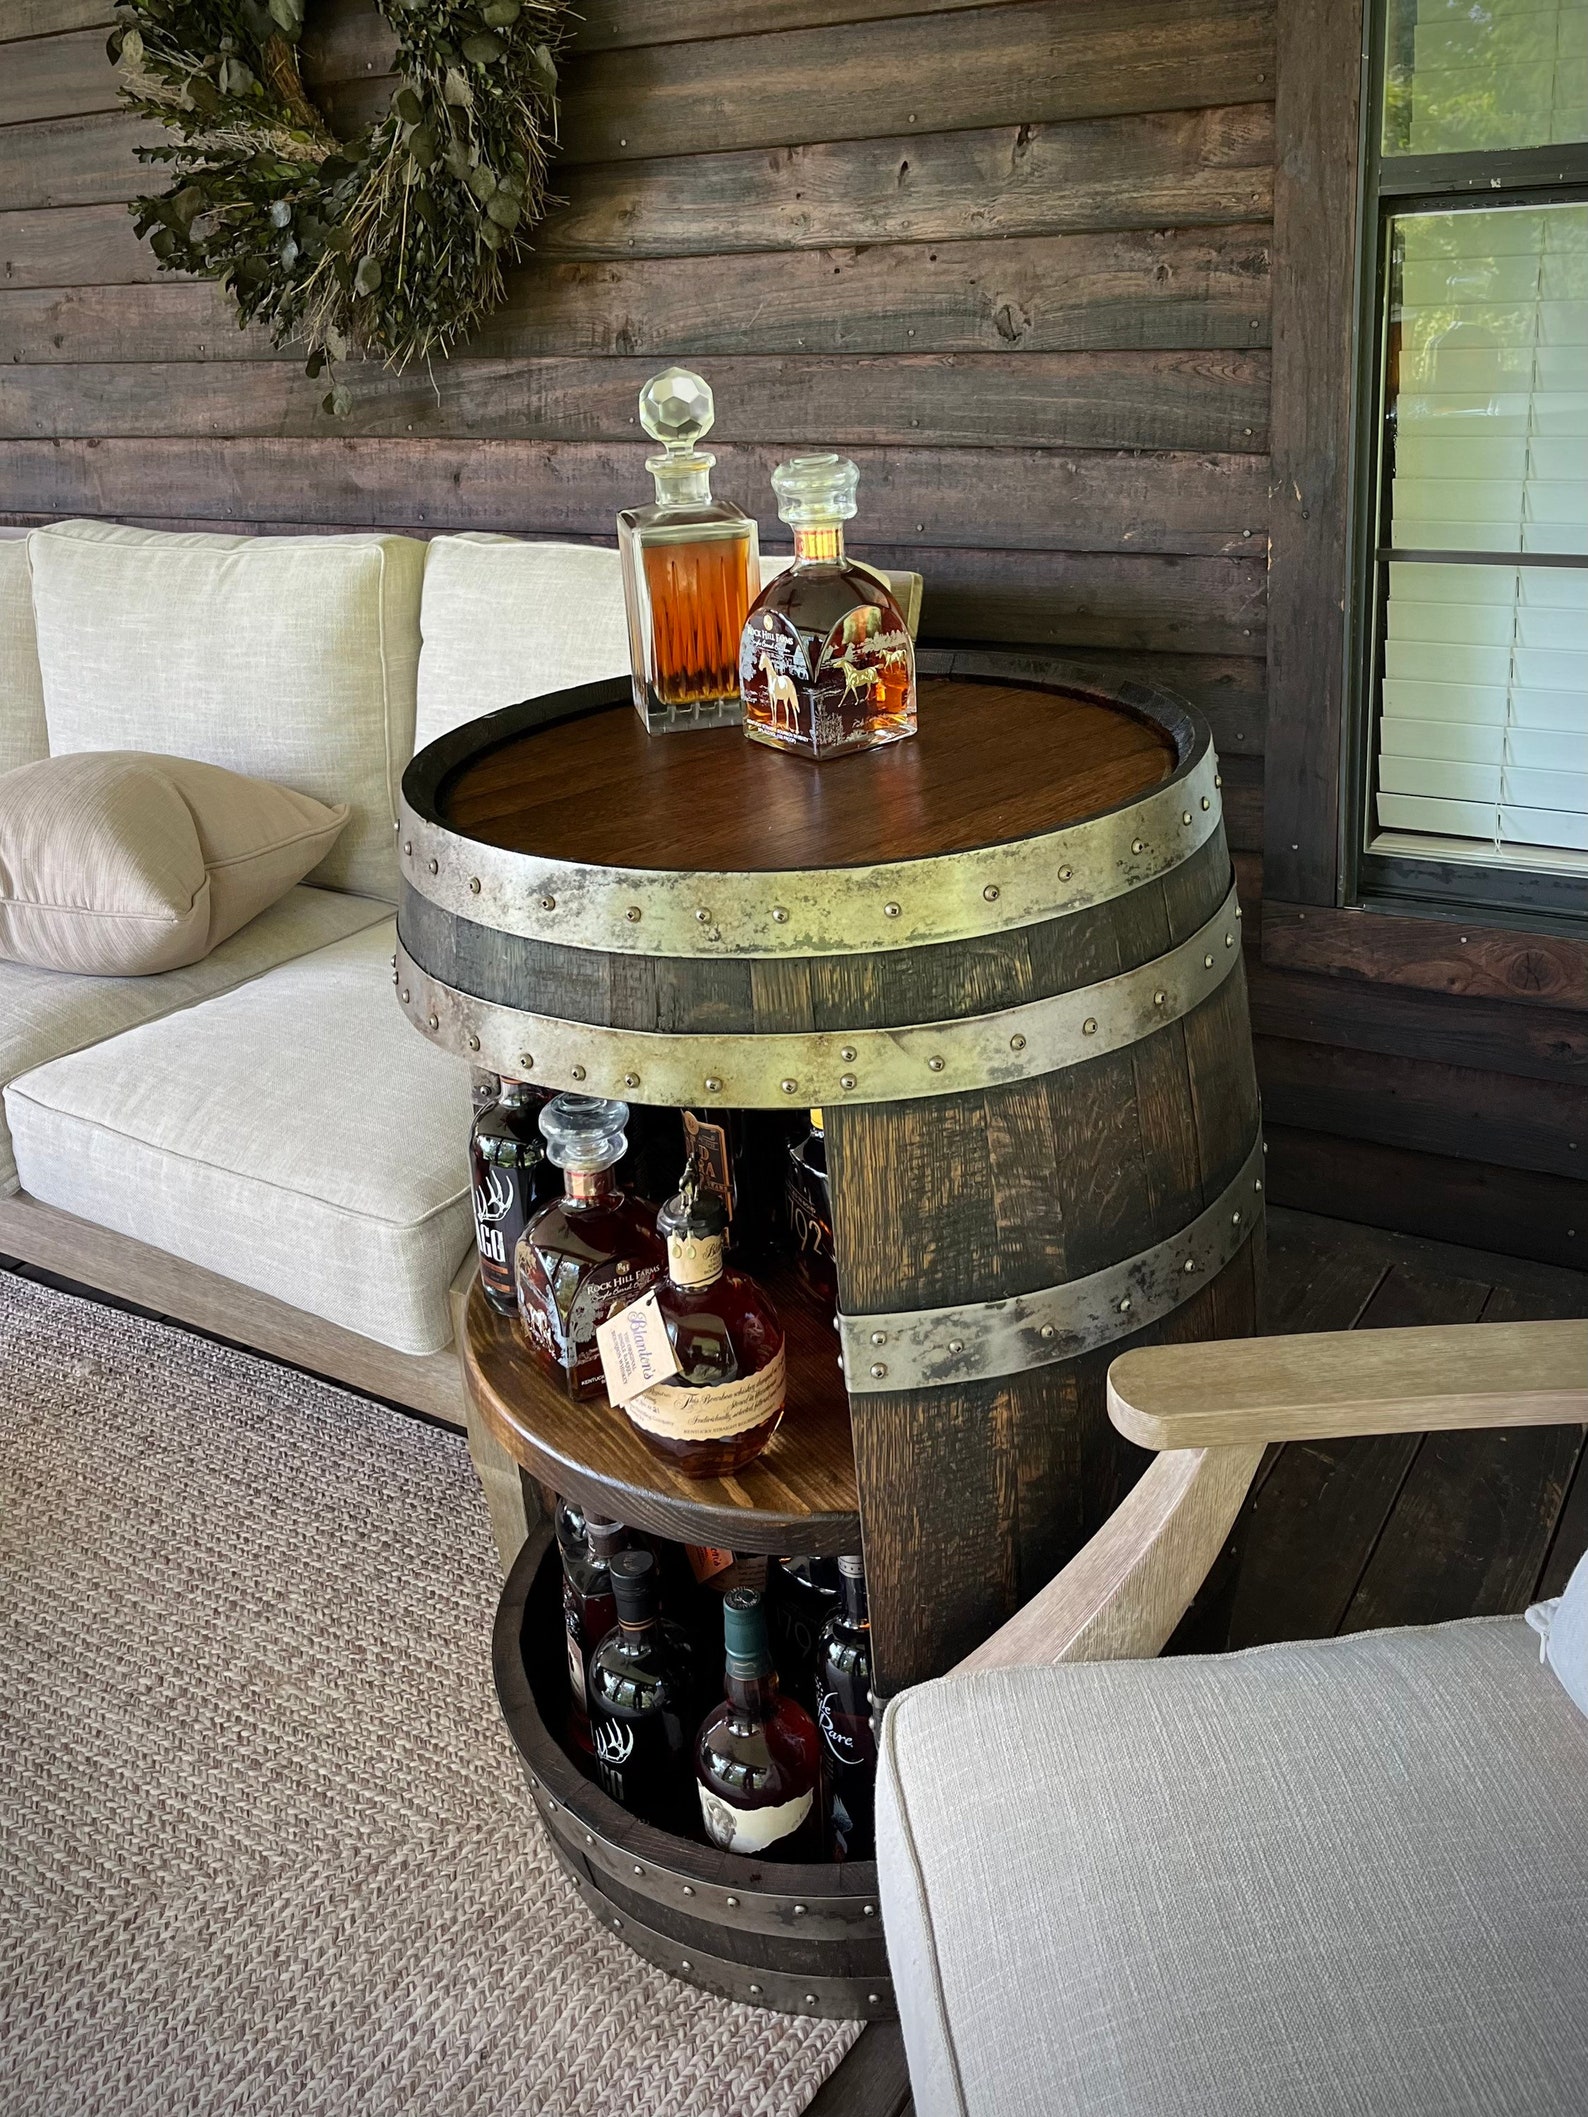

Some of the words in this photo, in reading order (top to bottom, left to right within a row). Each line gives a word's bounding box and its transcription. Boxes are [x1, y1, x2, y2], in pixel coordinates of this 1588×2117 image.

[587, 1281, 612, 1295] ROCK
[613, 1274, 634, 1288] HILL
[635, 1264, 660, 1280] FARMS
[627, 1311, 654, 1380] Blanton's
